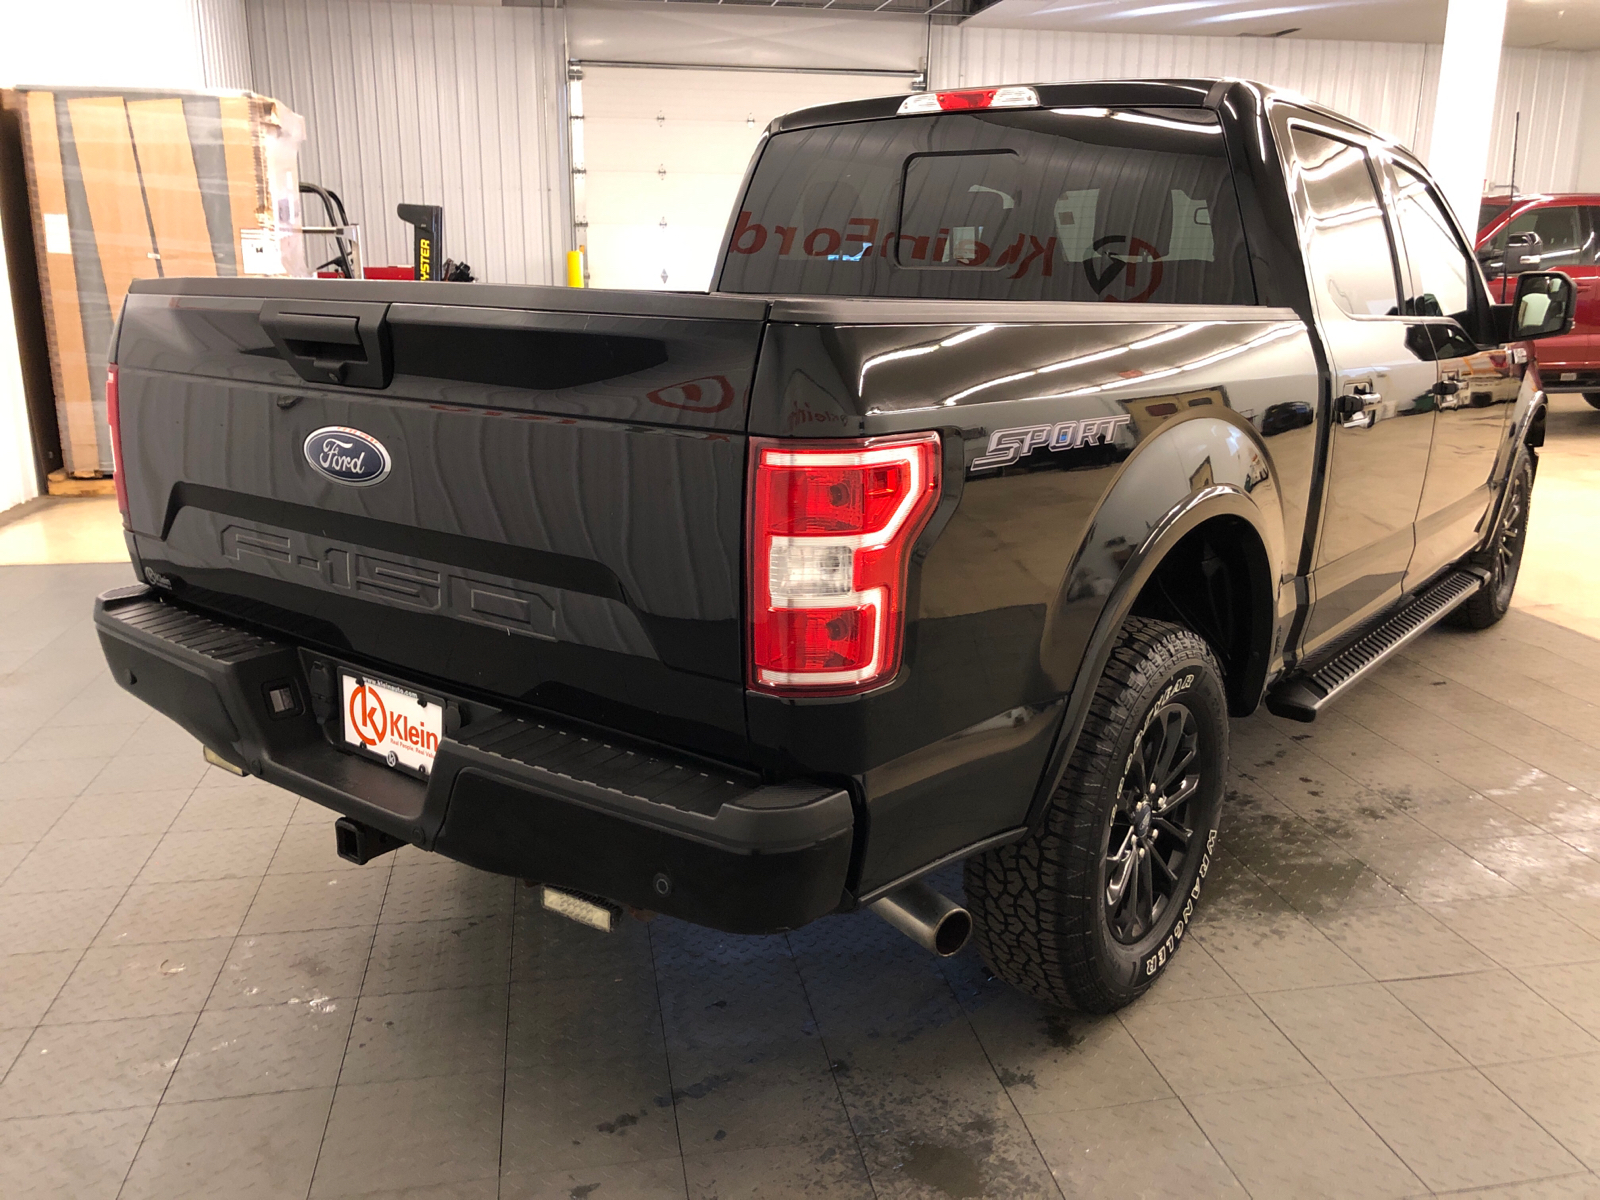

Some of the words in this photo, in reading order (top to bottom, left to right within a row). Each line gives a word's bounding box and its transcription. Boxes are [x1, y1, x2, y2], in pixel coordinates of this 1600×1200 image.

[320, 438, 365, 474] Ford
[970, 414, 1131, 471] SPORT
[221, 524, 557, 643] F-150
[390, 711, 438, 752] Klein
[1110, 674, 1195, 827] GOODYEAR
[1146, 829, 1217, 977] WRANGLER
